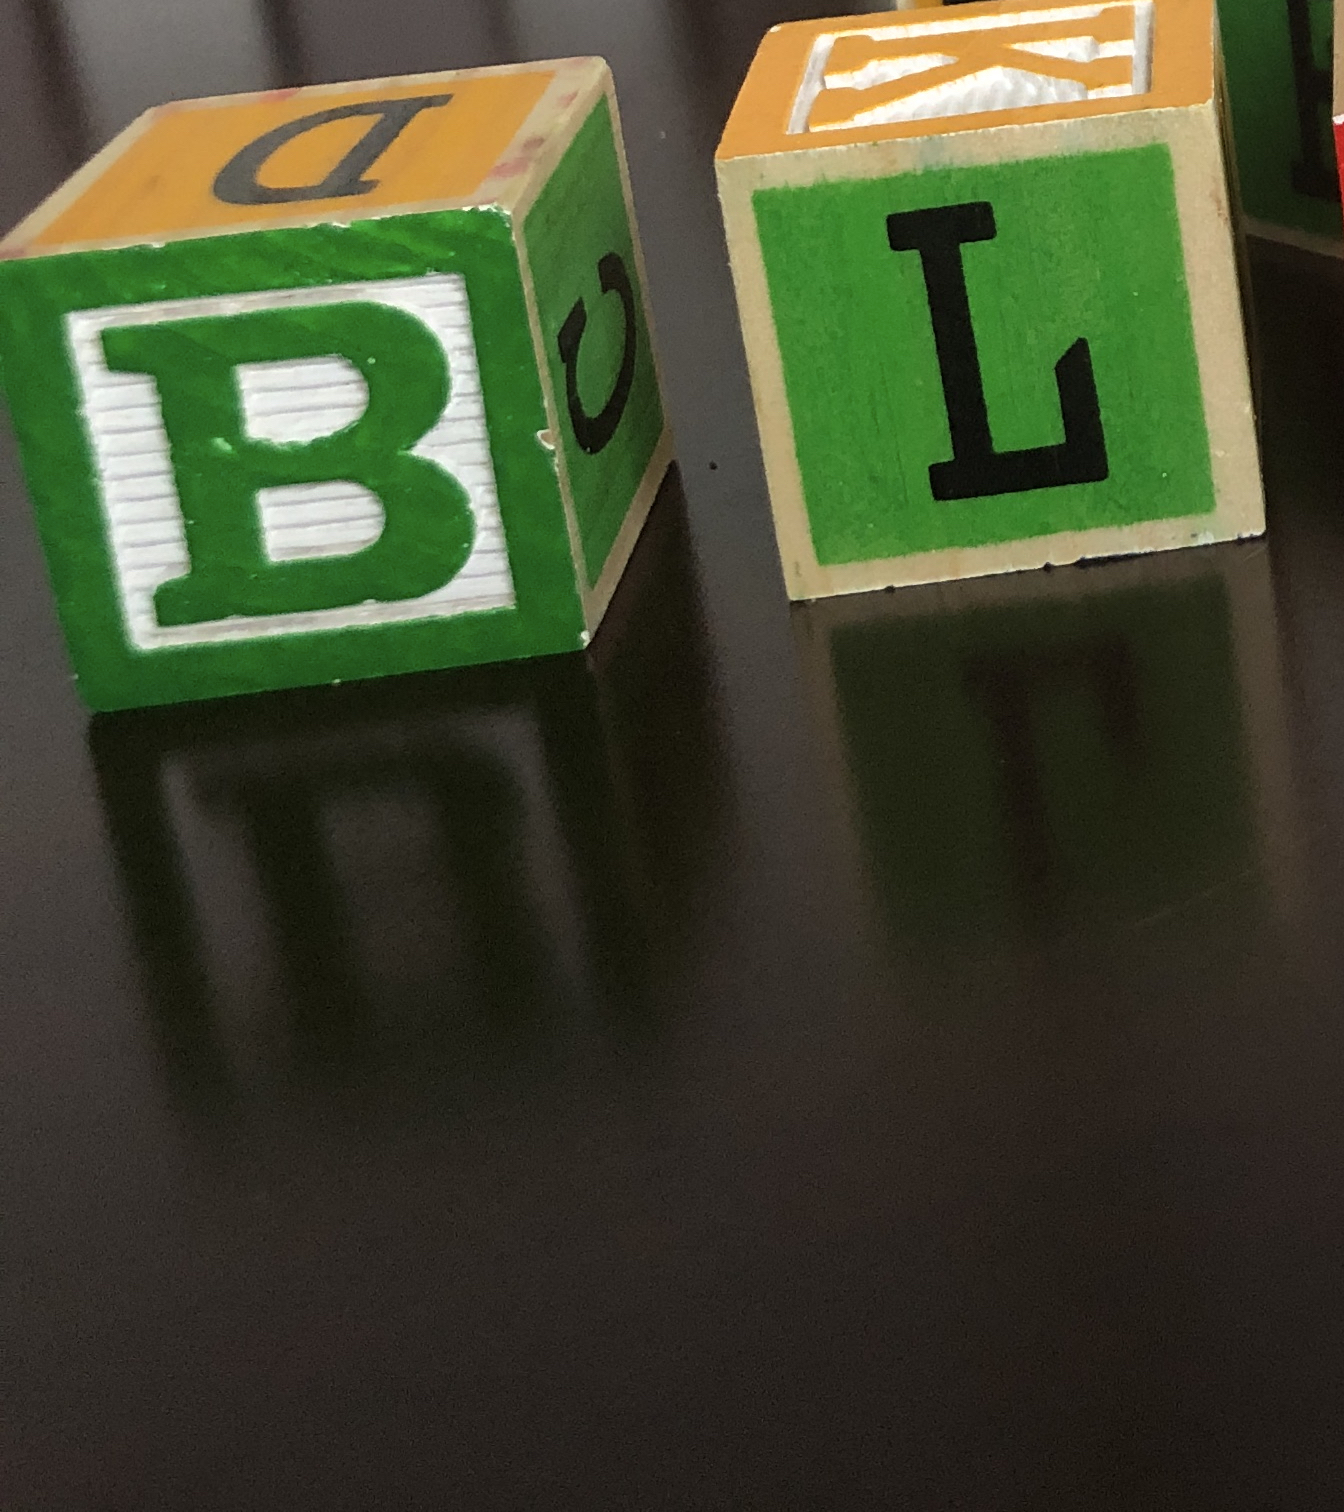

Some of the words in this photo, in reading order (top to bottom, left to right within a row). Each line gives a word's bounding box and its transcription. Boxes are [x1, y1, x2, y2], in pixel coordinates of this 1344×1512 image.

[211, 93, 455, 207] D
[100, 300, 478, 629] B
[557, 251, 637, 456] C
[885, 200, 1111, 503] L
